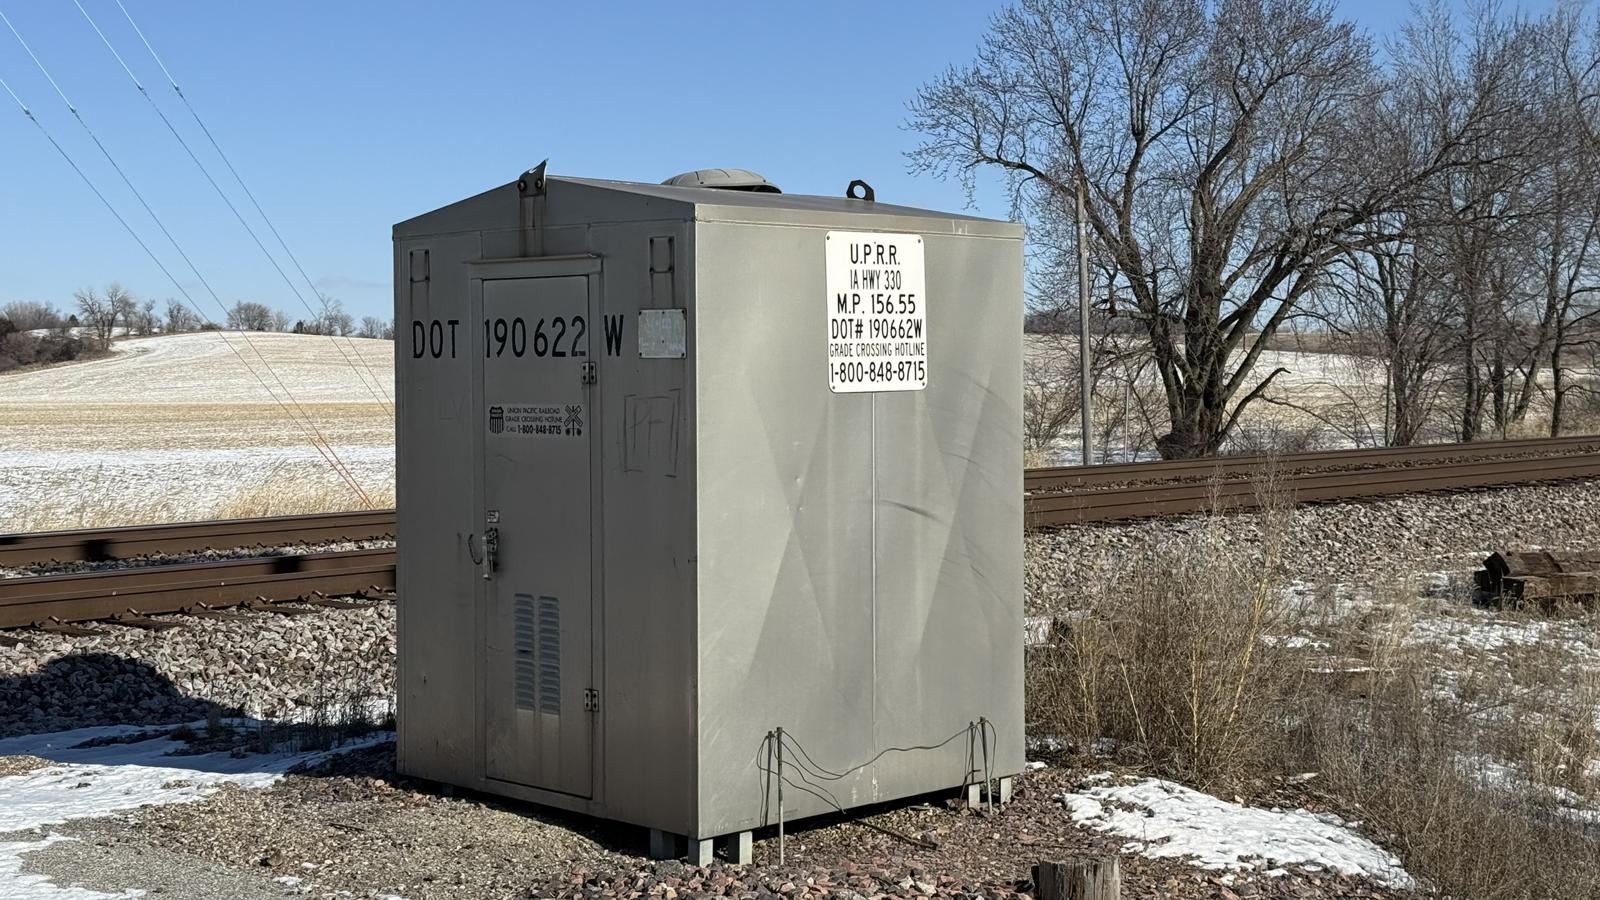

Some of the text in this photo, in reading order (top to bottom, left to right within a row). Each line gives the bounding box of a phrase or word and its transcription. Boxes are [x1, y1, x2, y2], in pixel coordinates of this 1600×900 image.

[850, 243, 901, 265] U.P.R.R.
[850, 269, 902, 290] IA HWY 330
[837, 293, 916, 314] M.P. 156.55
[412, 319, 459, 359] DOT
[603, 314, 624, 357] W
[831, 318, 923, 339] DOT# 190662W
[829, 342, 925, 357] GRADE CROSSING HOTLINE
[830, 361, 925, 383] 1-800-848-8715
[517, 424, 562, 435] 1-800-848-8715
